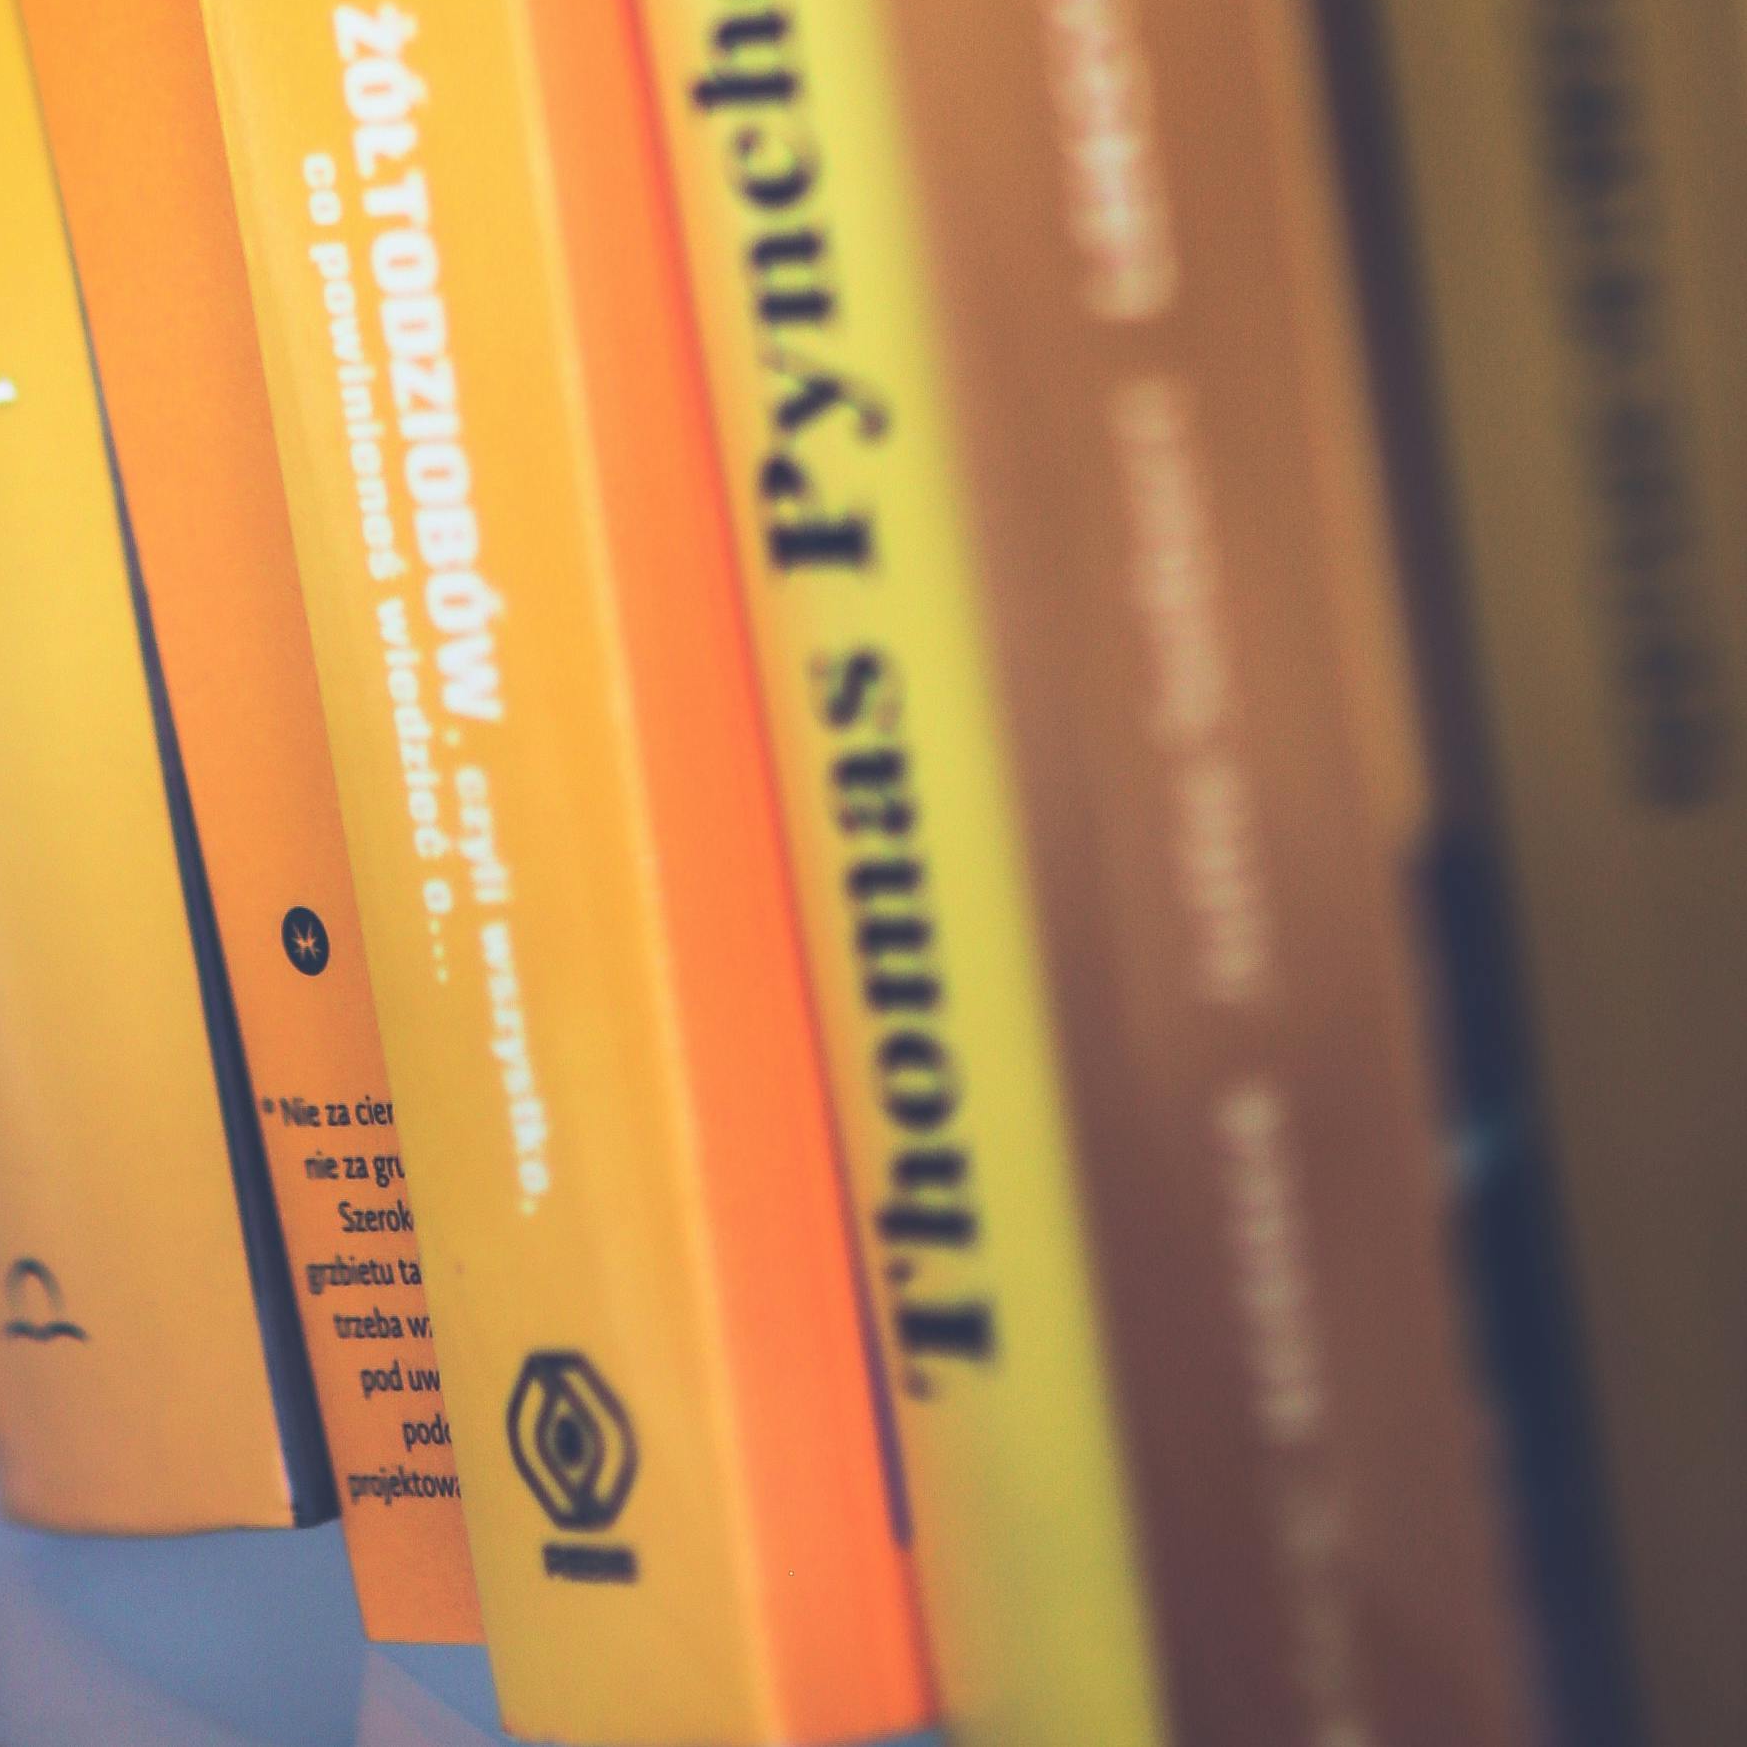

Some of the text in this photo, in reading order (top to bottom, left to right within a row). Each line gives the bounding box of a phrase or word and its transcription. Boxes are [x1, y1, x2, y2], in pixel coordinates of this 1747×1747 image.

[301, 149, 344, 227] co
[812, 645, 1000, 1405] Thomas
[325, 1101, 351, 1127] za
[342, 1155, 370, 1180] za
[333, 1305, 405, 1339] trzeba
[360, 1359, 403, 1400] pod
